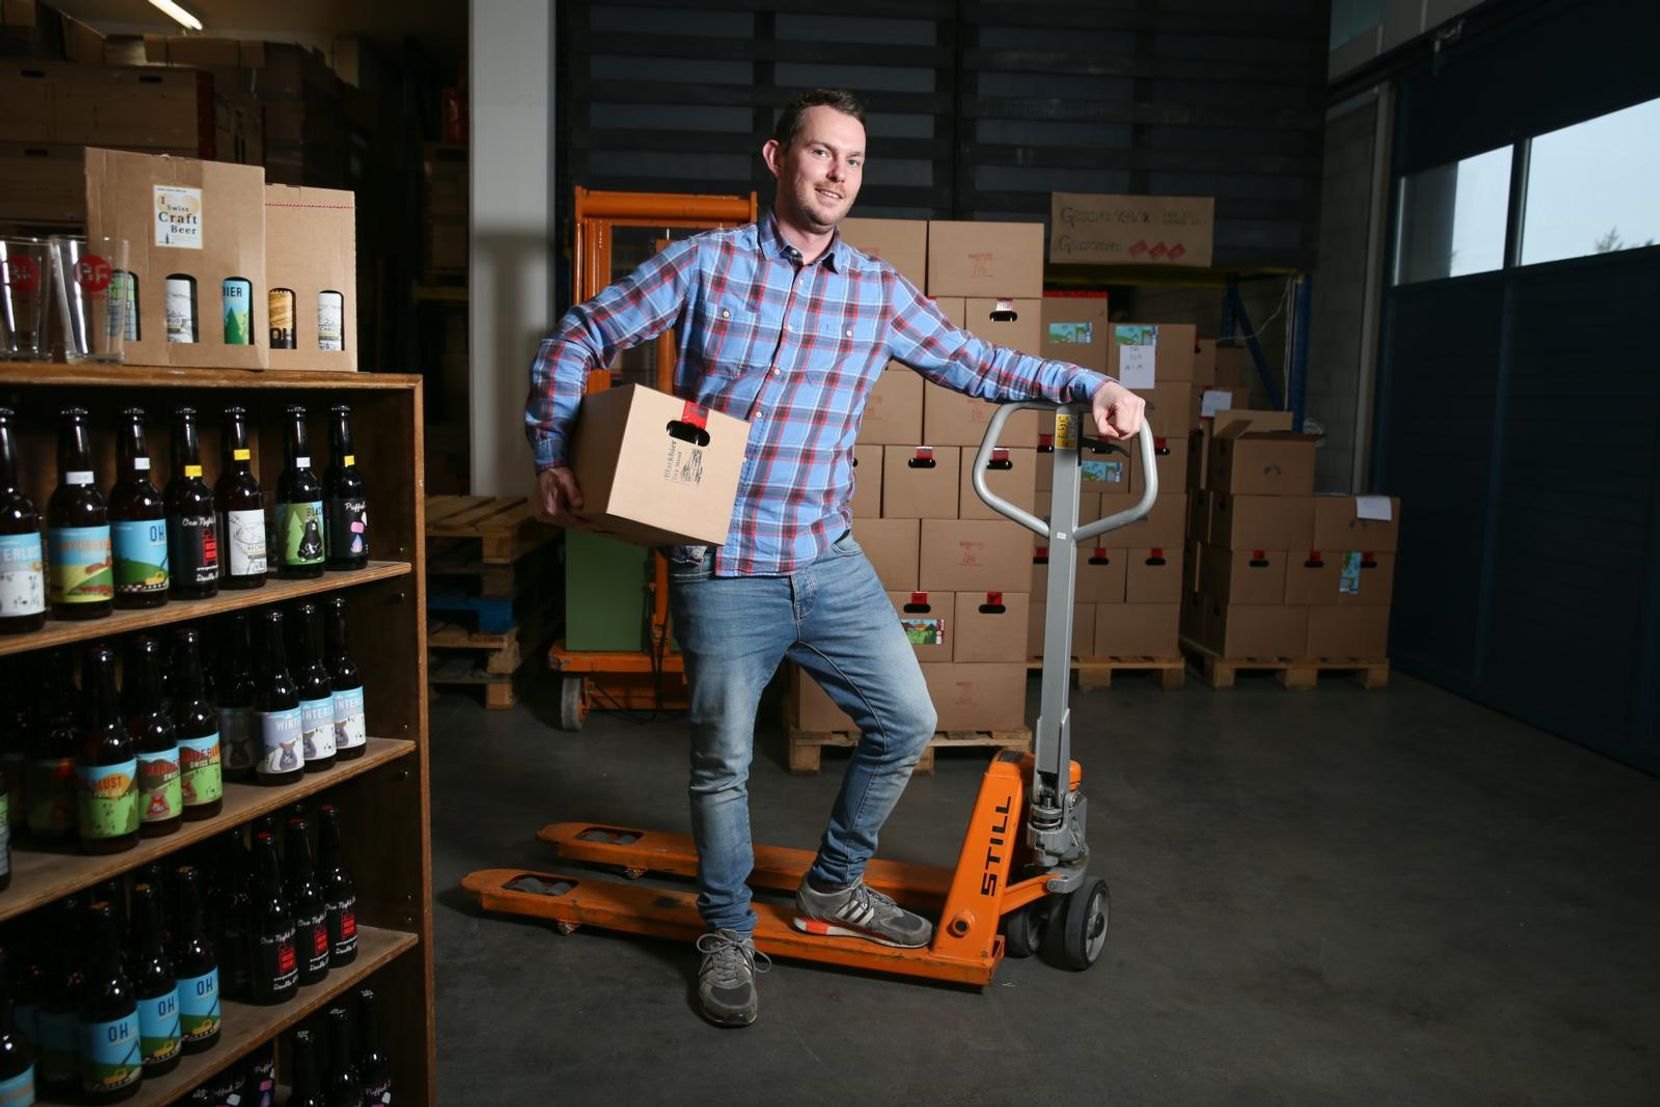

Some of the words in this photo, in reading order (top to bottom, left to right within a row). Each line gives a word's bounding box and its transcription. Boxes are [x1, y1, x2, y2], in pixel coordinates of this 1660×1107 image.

[158, 210, 199, 225] Craft
[170, 224, 198, 236] Beer
[981, 796, 1011, 896] STILL
[196, 976, 213, 996] OH
[158, 997, 175, 1016] OH
[108, 1022, 129, 1042] OH
